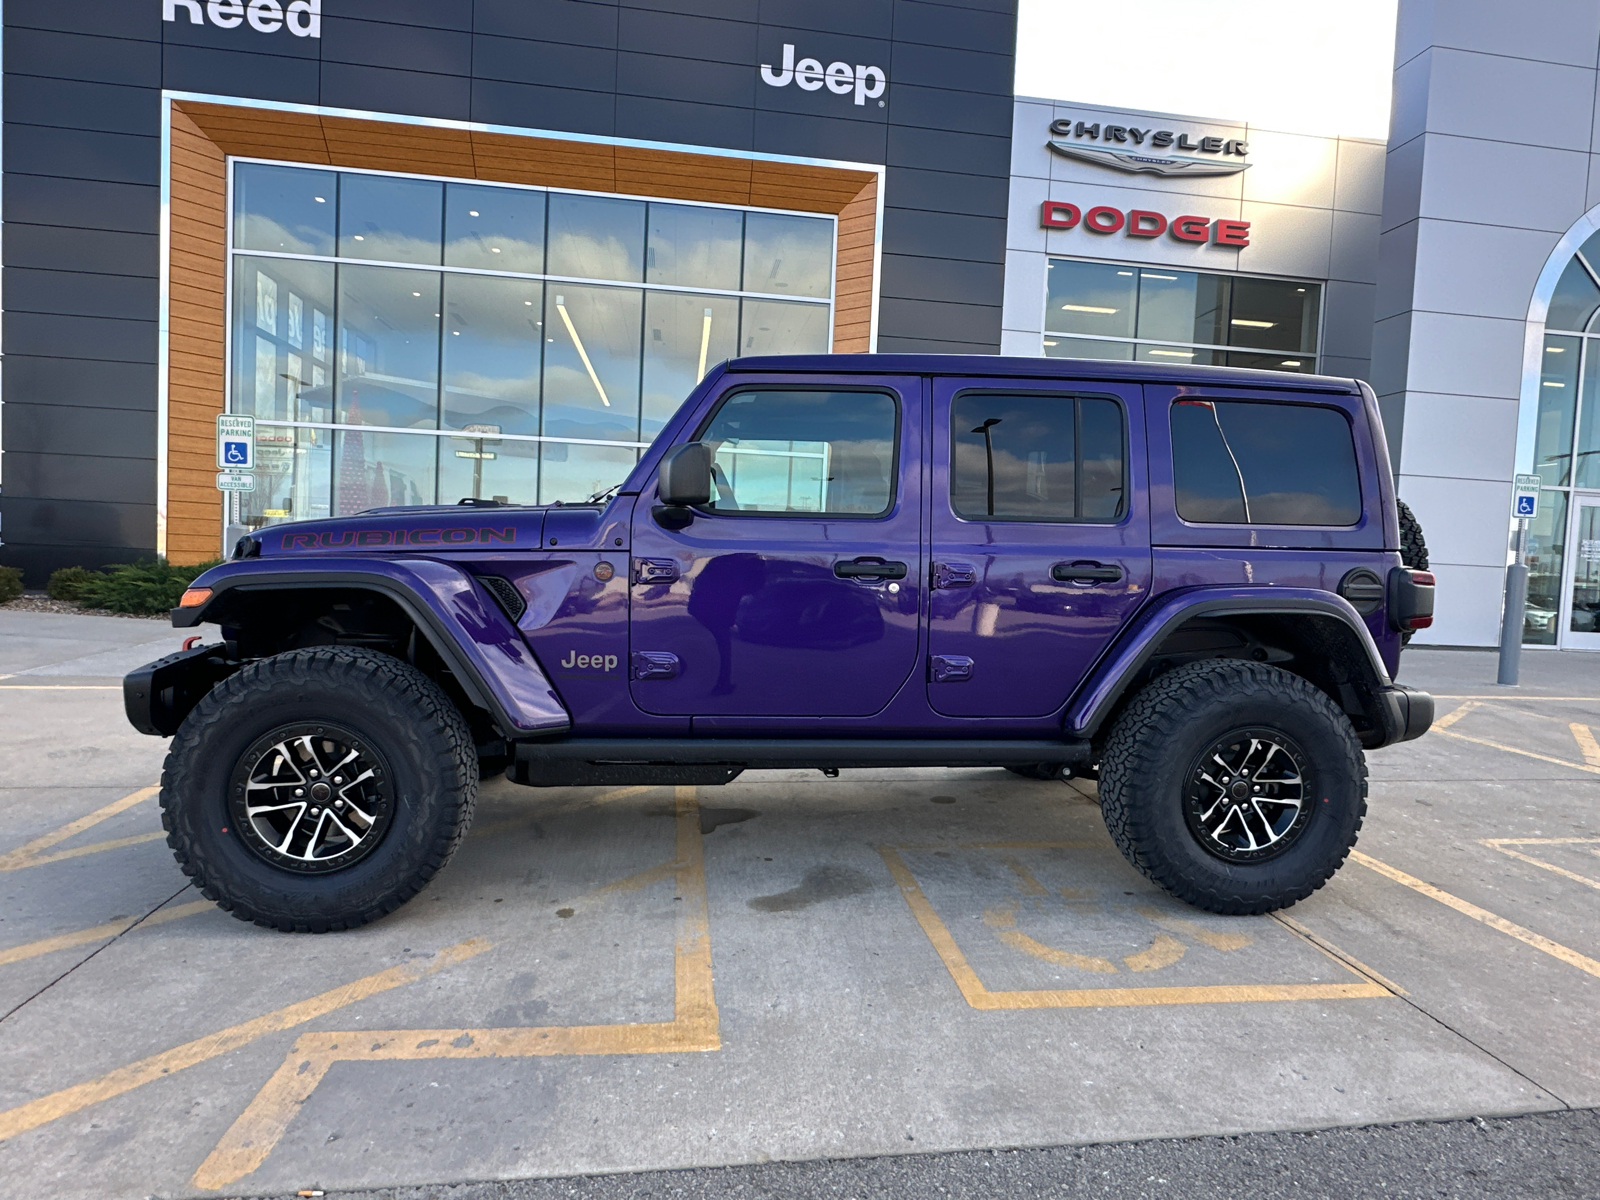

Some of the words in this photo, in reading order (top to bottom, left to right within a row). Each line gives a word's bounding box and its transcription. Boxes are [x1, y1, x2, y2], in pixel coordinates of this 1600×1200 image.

[760, 43, 886, 106] Jeep
[1050, 118, 1250, 155] CHRYSLER
[1040, 200, 1251, 248] DODGE
[220, 418, 252, 428] RESERVED
[220, 428, 252, 437] PARKING
[219, 481, 252, 489] ACCESSIBLE
[281, 527, 517, 550] RUBICON
[561, 650, 618, 672] Jeep
